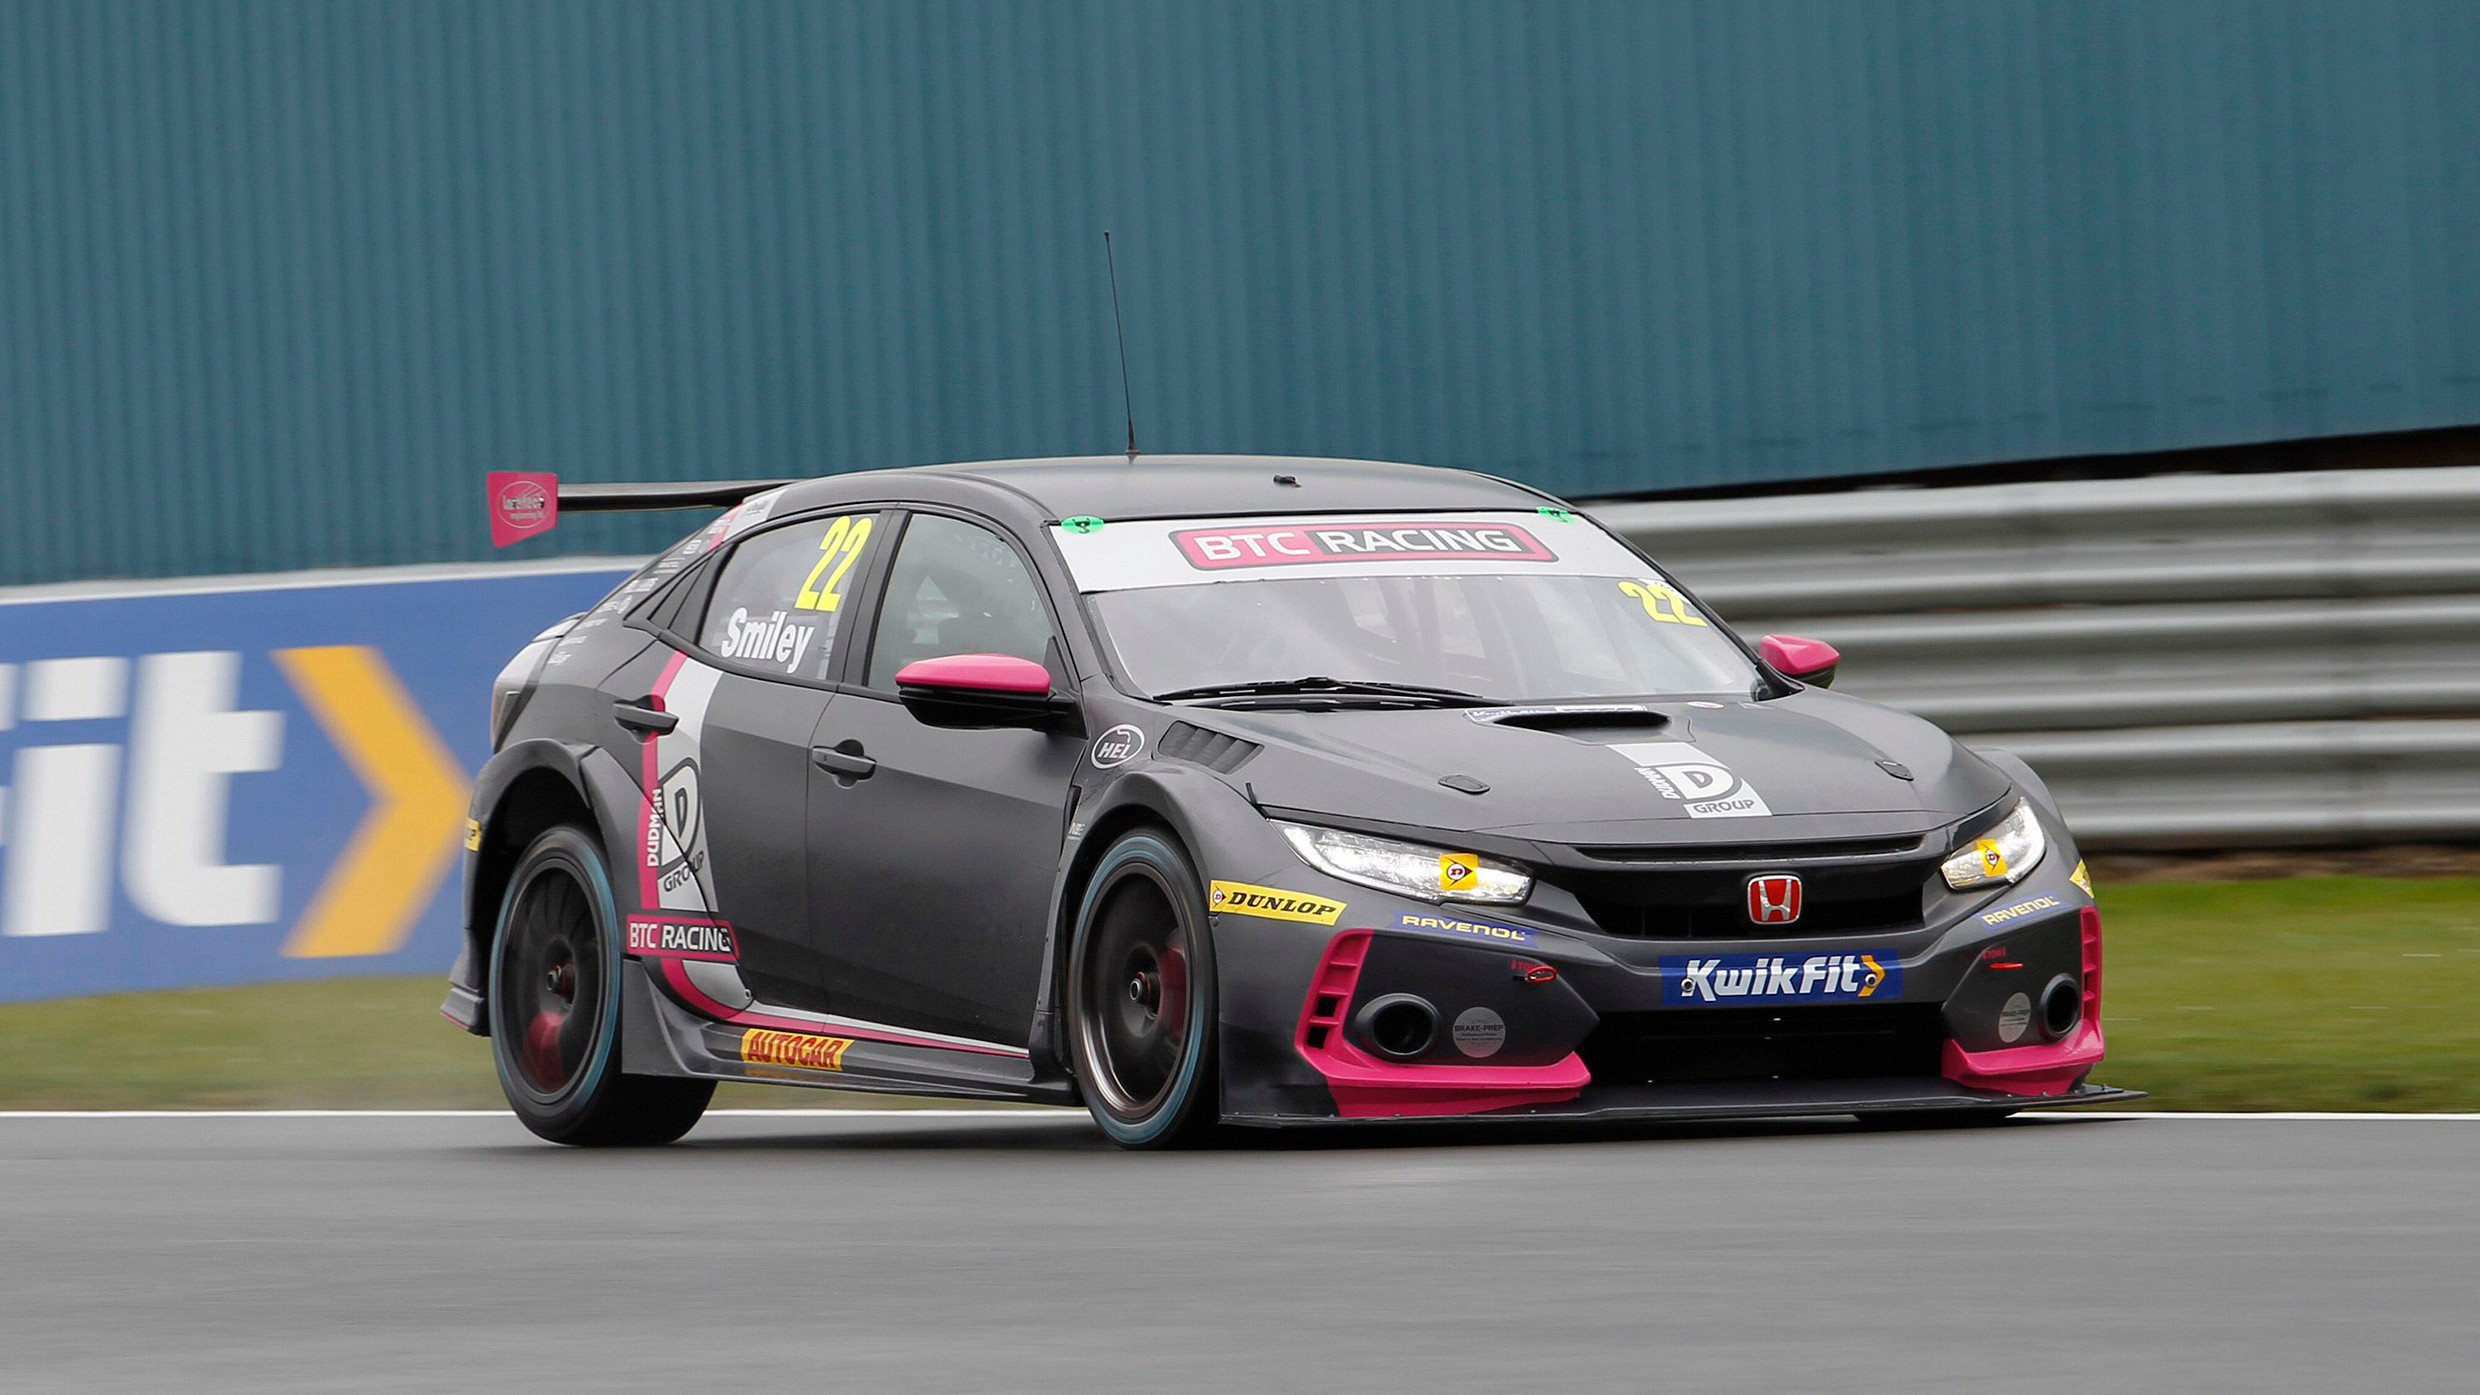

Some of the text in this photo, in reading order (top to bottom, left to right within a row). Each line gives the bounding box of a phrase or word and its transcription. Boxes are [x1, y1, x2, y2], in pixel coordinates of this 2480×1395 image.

[1194, 529, 1522, 561] BTC RACING
[794, 515, 873, 612] 22
[1617, 581, 1708, 627] 22
[721, 607, 815, 674] Smiley
[1098, 742, 1131, 759] HEL
[0, 651, 287, 937] it
[1693, 799, 1755, 813] GROUP
[647, 788, 665, 867] DUDMAN
[662, 850, 705, 893] GROUP
[1228, 891, 1337, 915] DUNLOP
[1981, 896, 2060, 925] RAVENOL
[630, 923, 731, 952] BTC RACING
[1402, 915, 1525, 941] RAVENOL
[748, 1031, 843, 1068] AUTOCAR
